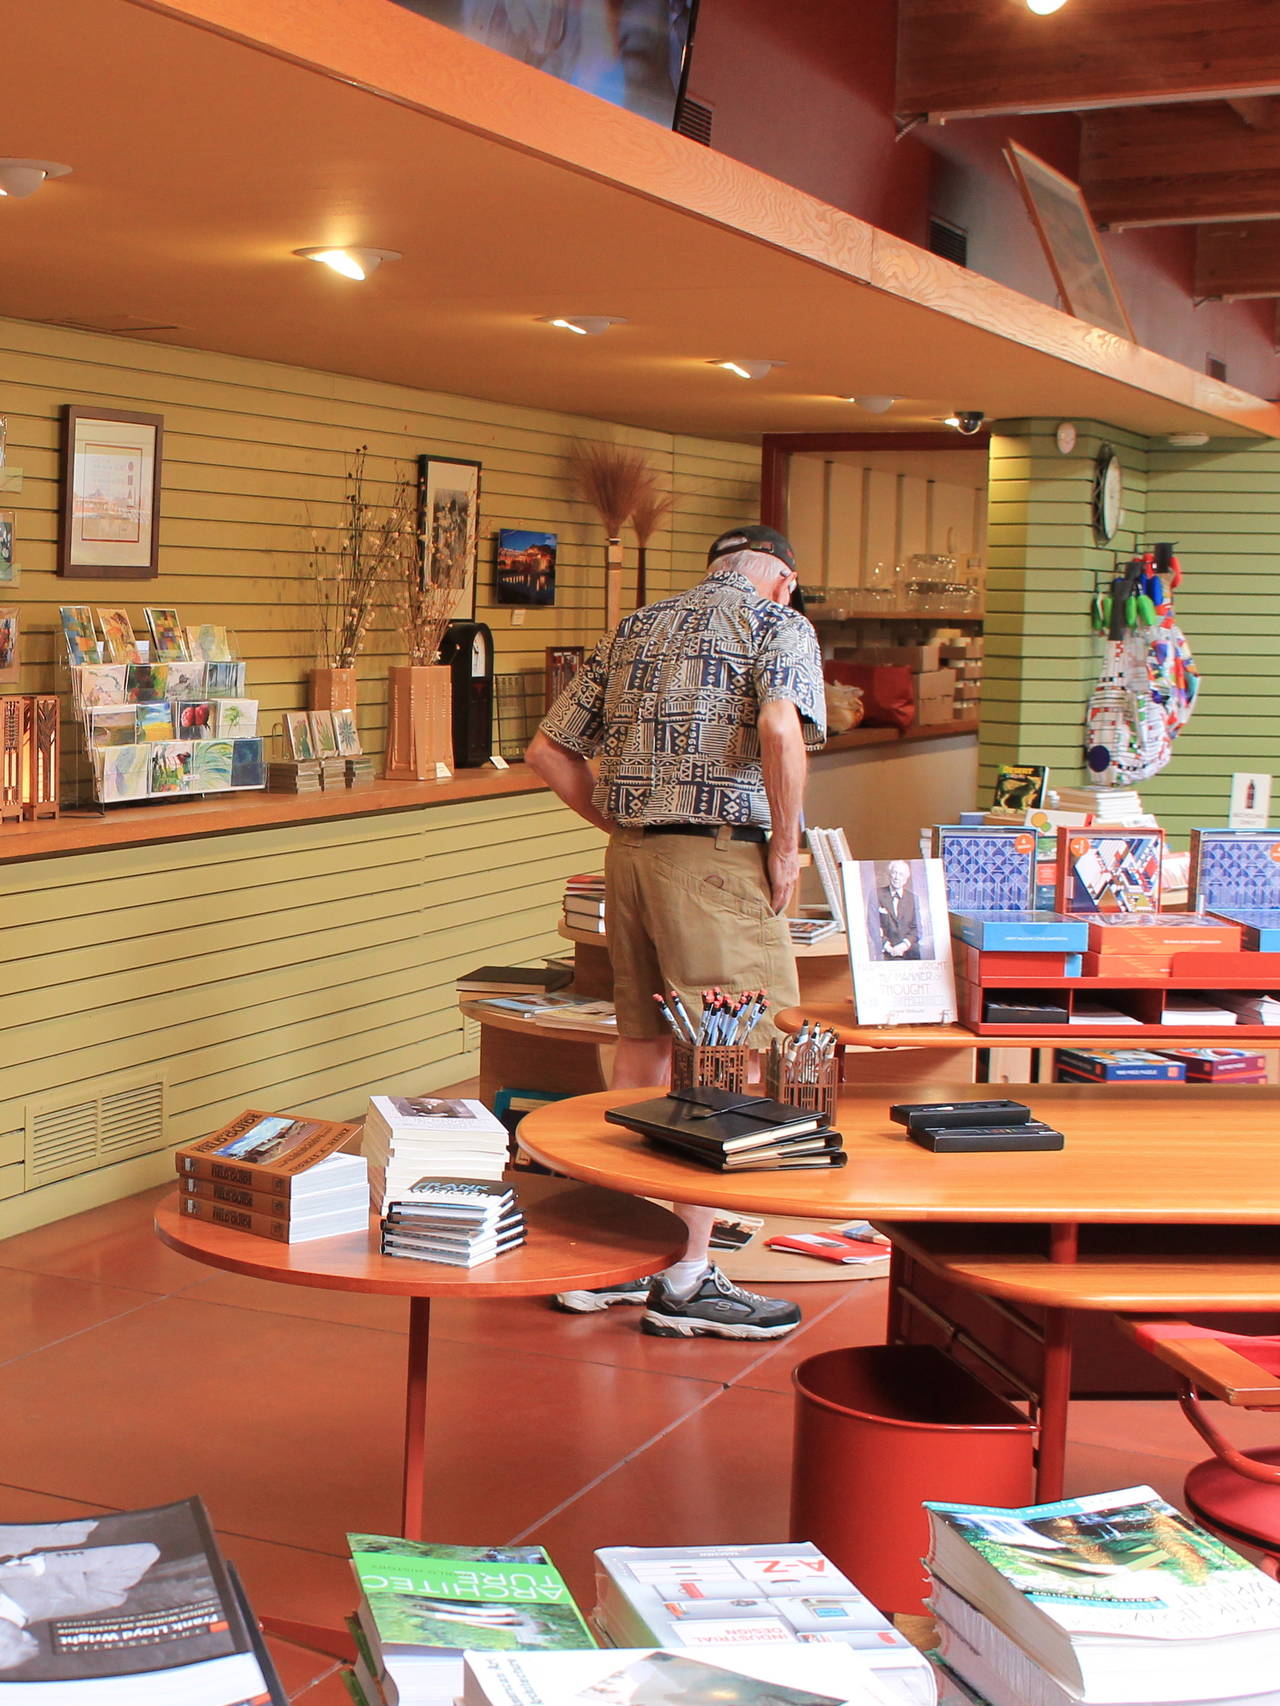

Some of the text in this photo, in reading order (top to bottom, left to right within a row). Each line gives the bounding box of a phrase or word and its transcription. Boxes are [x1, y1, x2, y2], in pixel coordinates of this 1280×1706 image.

[754, 1558, 826, 1573] A-Z
[360, 1575, 564, 1601] ARCHITEC
[454, 1570, 562, 1588] TURE
[58, 1614, 218, 1645] Frank Lloyd Wright
[724, 1626, 782, 1636] DESIGN
